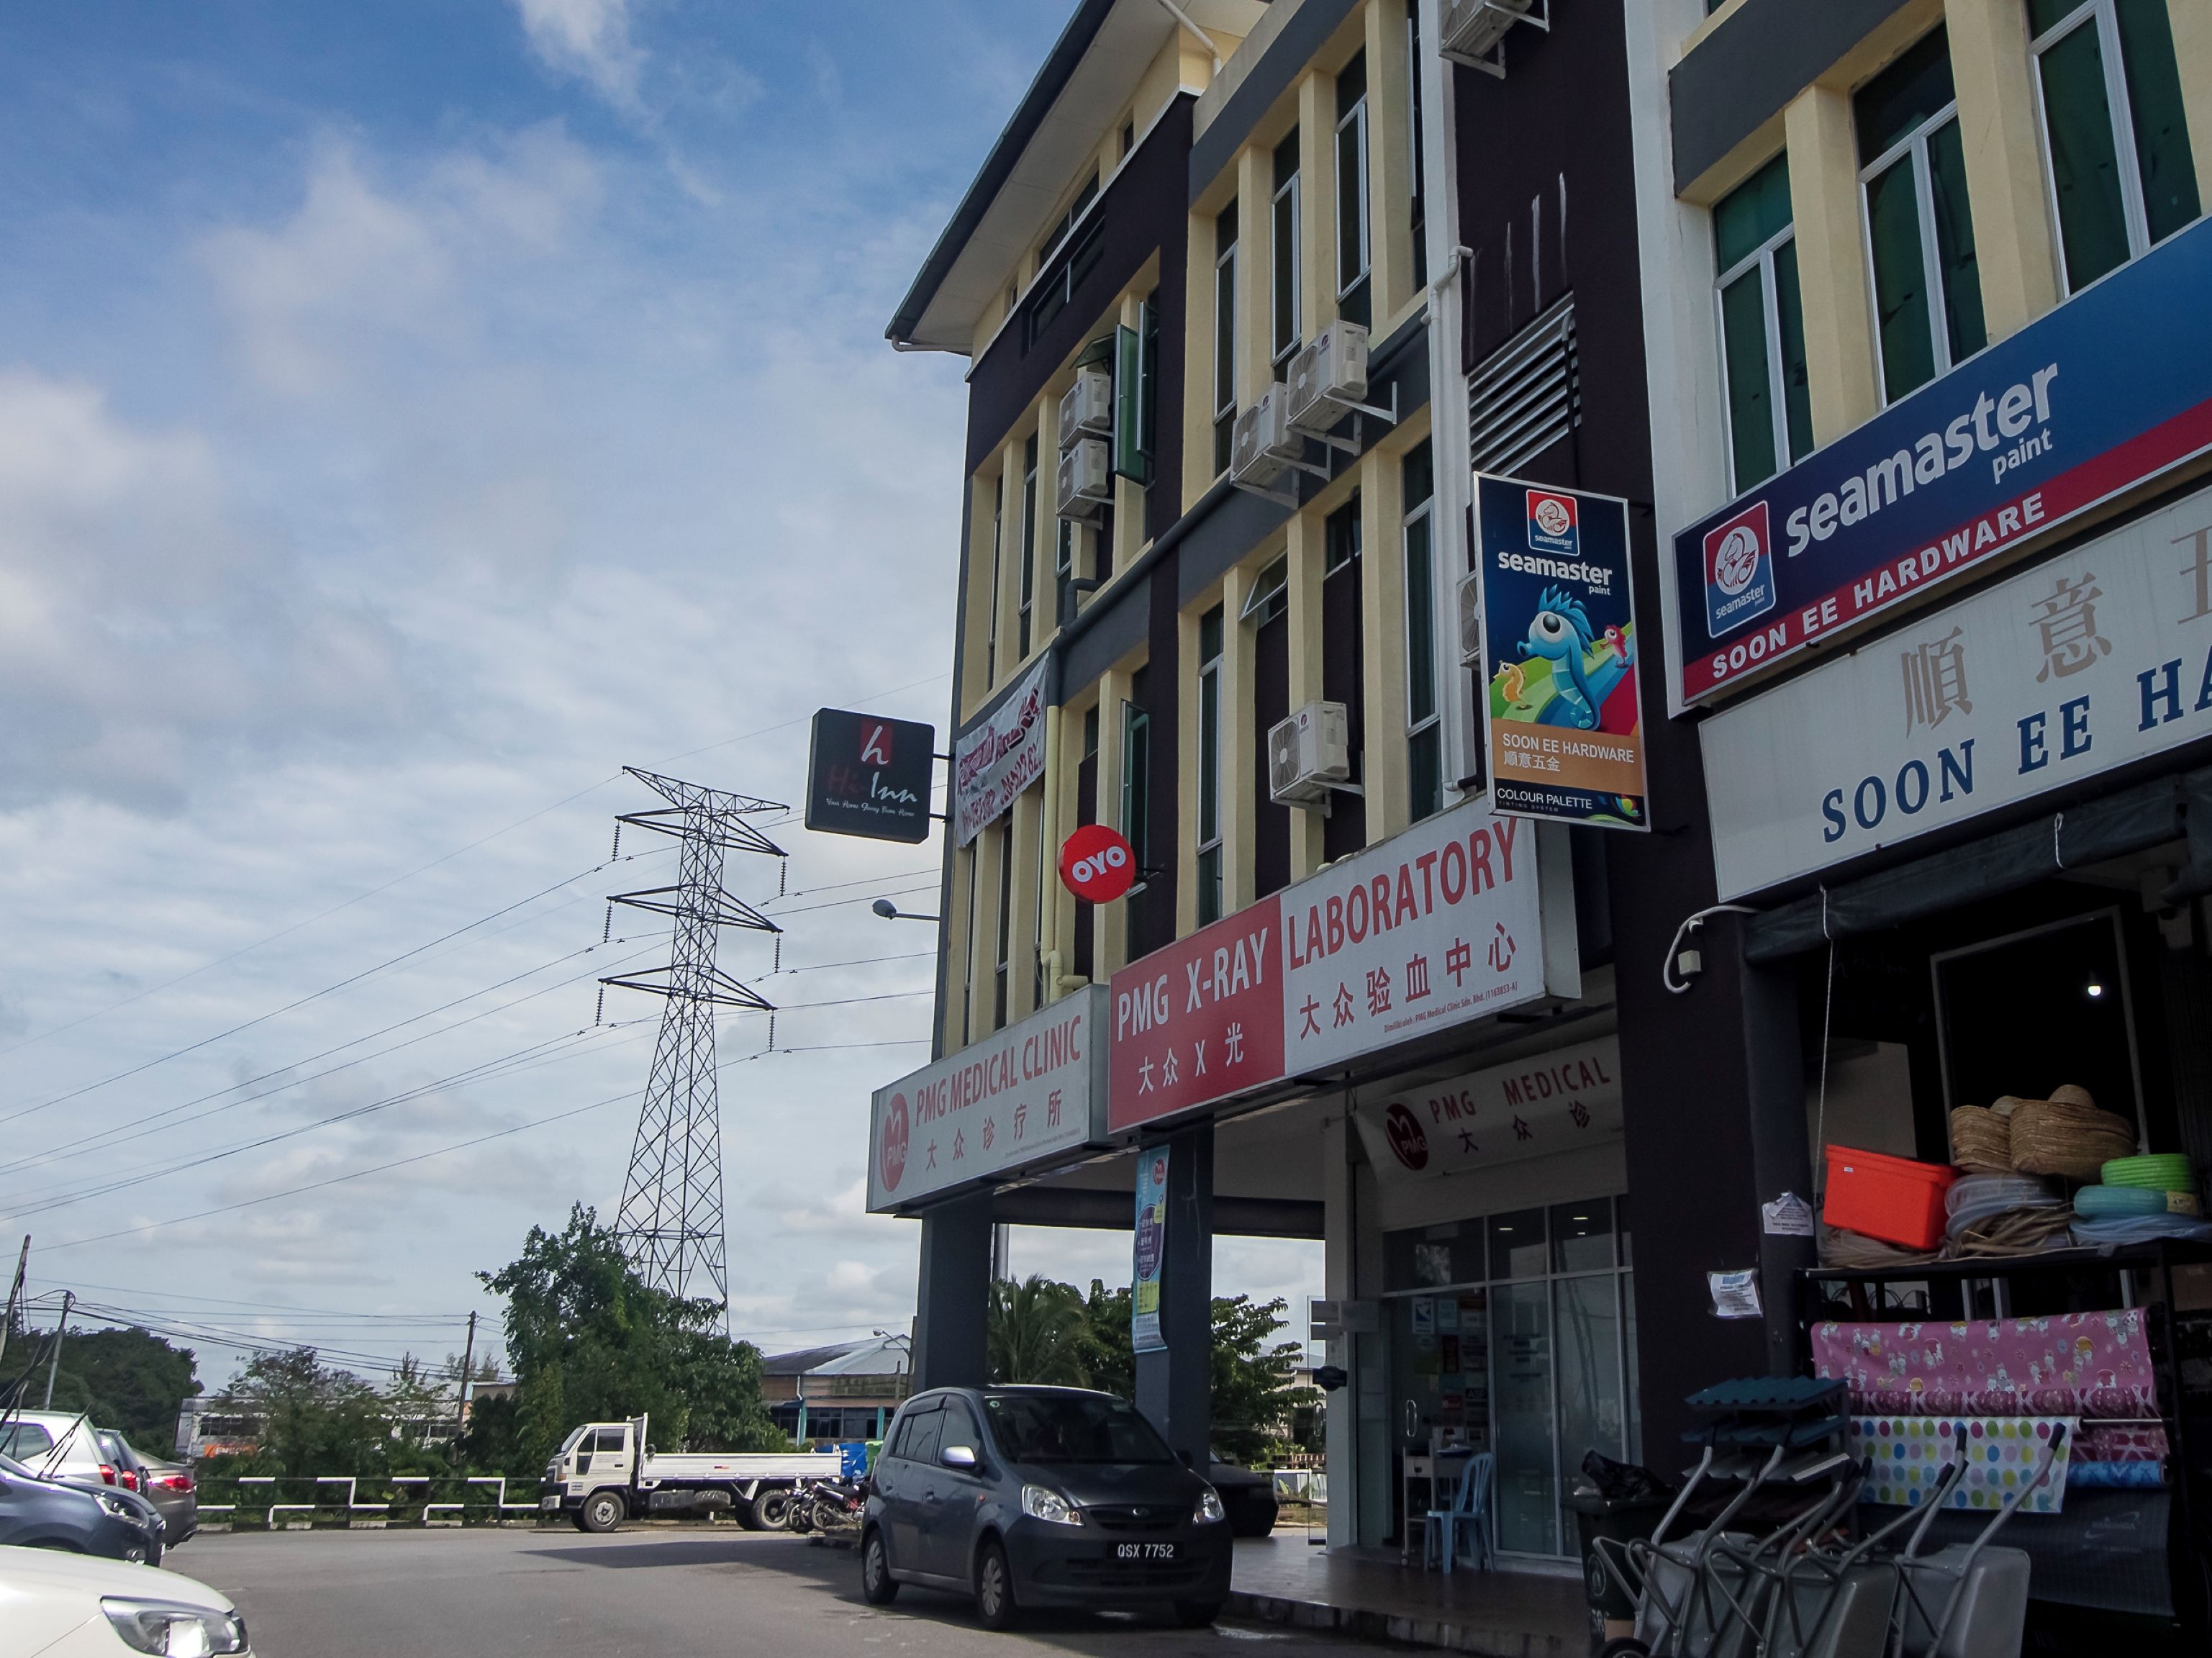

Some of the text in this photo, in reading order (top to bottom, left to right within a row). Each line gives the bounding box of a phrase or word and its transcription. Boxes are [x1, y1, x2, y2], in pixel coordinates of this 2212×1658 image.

[1786, 362, 2058, 557] seamaster
[1993, 427, 2053, 485] paint
[1535, 535, 1573, 546] seamaster
[1498, 551, 1613, 585] seamaster
[1713, 491, 2046, 679] SOON EE HARDWARE
[1589, 585, 1611, 596] paint
[1715, 584, 1765, 619] seamaster
[1502, 733, 1635, 763] SOON EE HARDWARE
[1821, 738, 1975, 843] SOON
[2016, 694, 2093, 776] EE
[871, 771, 917, 802] Inn
[1497, 787, 1592, 810] COLOUR PALETTE
[1072, 846, 1126, 882] OYO
[1288, 816, 1518, 971] LABORATORY
[1118, 927, 1268, 1042] PMG X-RAY
[1300, 921, 1517, 1041] 大众验血中心
[1415, 1013, 1427, 1023] PMG
[1427, 1004, 1446, 1020] Medical
[1446, 1001, 1461, 1013] Clinic
[1461, 997, 1472, 1007] Sdn.
[1473, 992, 1485, 1003] Bhd.
[915, 1015, 1081, 1127] PMG MEDICAL CLINIC
[1428, 1057, 1611, 1125] PMG MEDICAL
[925, 1088, 1062, 1172] 大众诊疗所
[1400, 1136, 1428, 1156] PMG
[887, 1141, 907, 1168] PMG
[1118, 1544, 1174, 1559] QSX 7752
